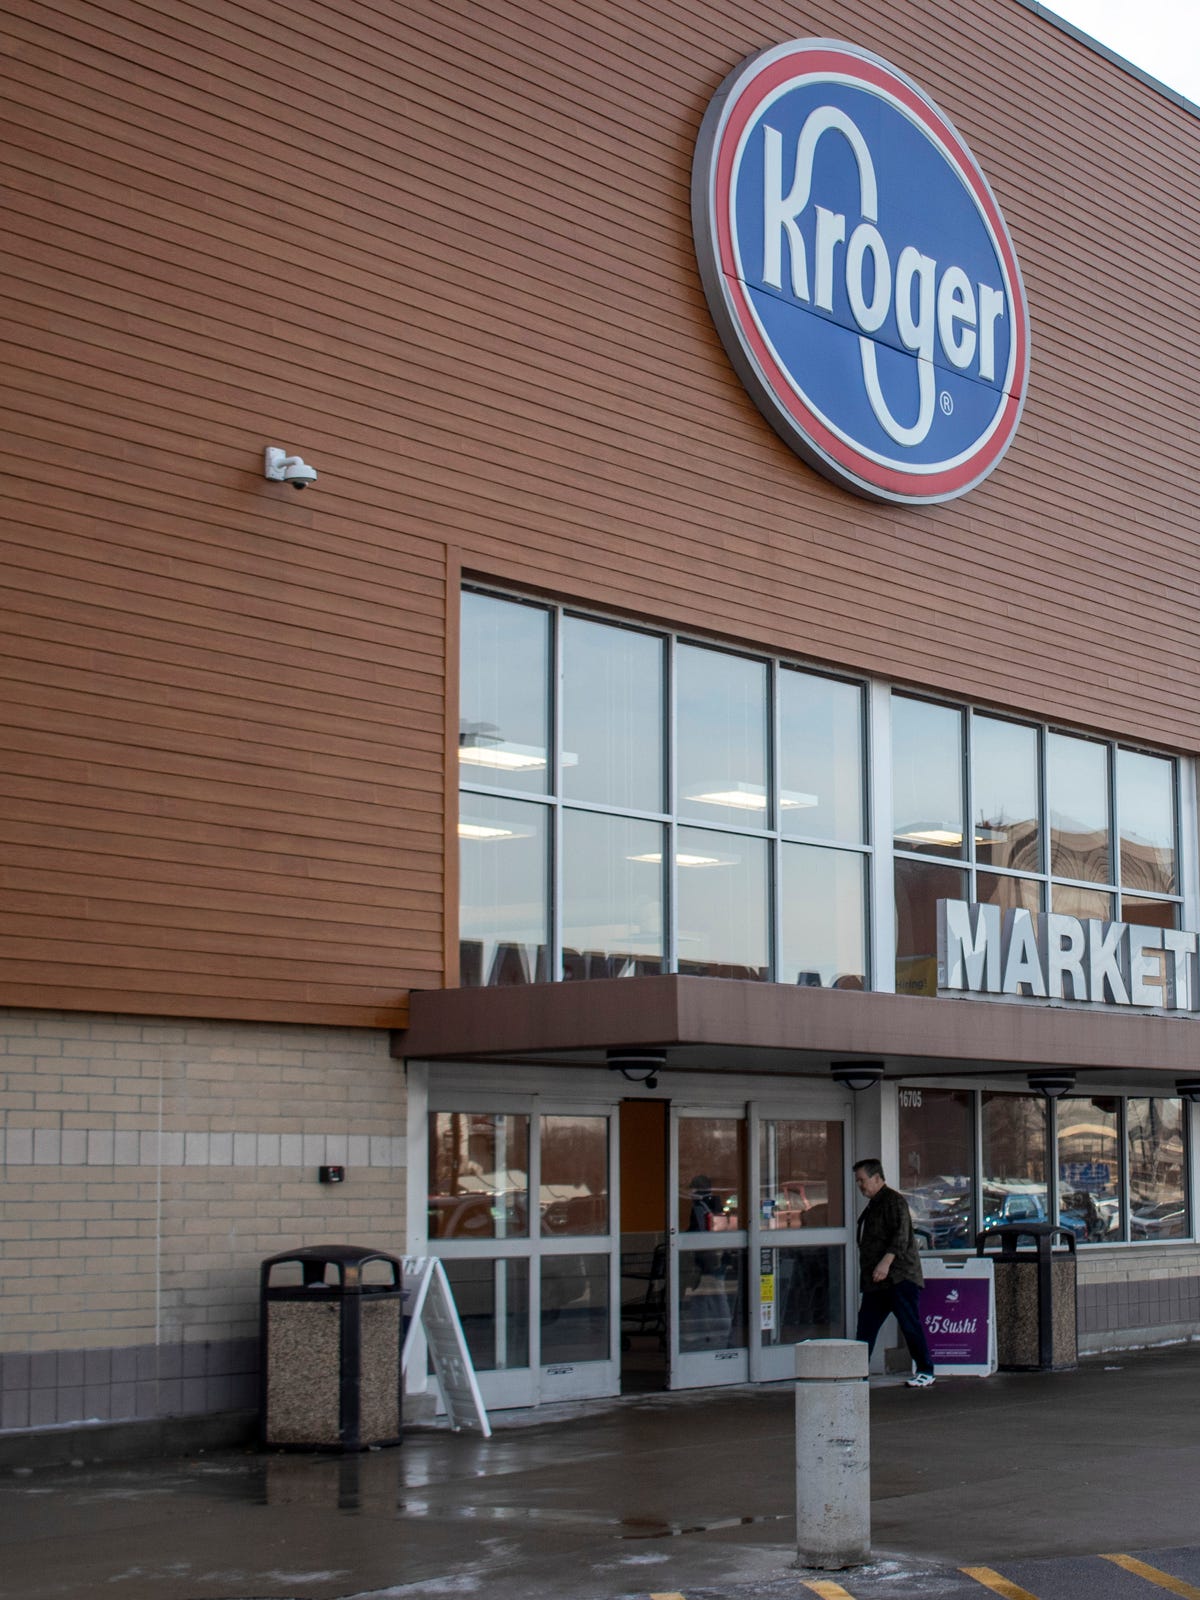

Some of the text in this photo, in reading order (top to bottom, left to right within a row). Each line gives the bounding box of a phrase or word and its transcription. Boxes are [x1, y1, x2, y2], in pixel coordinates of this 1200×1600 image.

[762, 105, 1004, 446] Kroger
[899, 1090, 922, 1107] 16705
[924, 1315, 977, 1334] $5 Sushi
